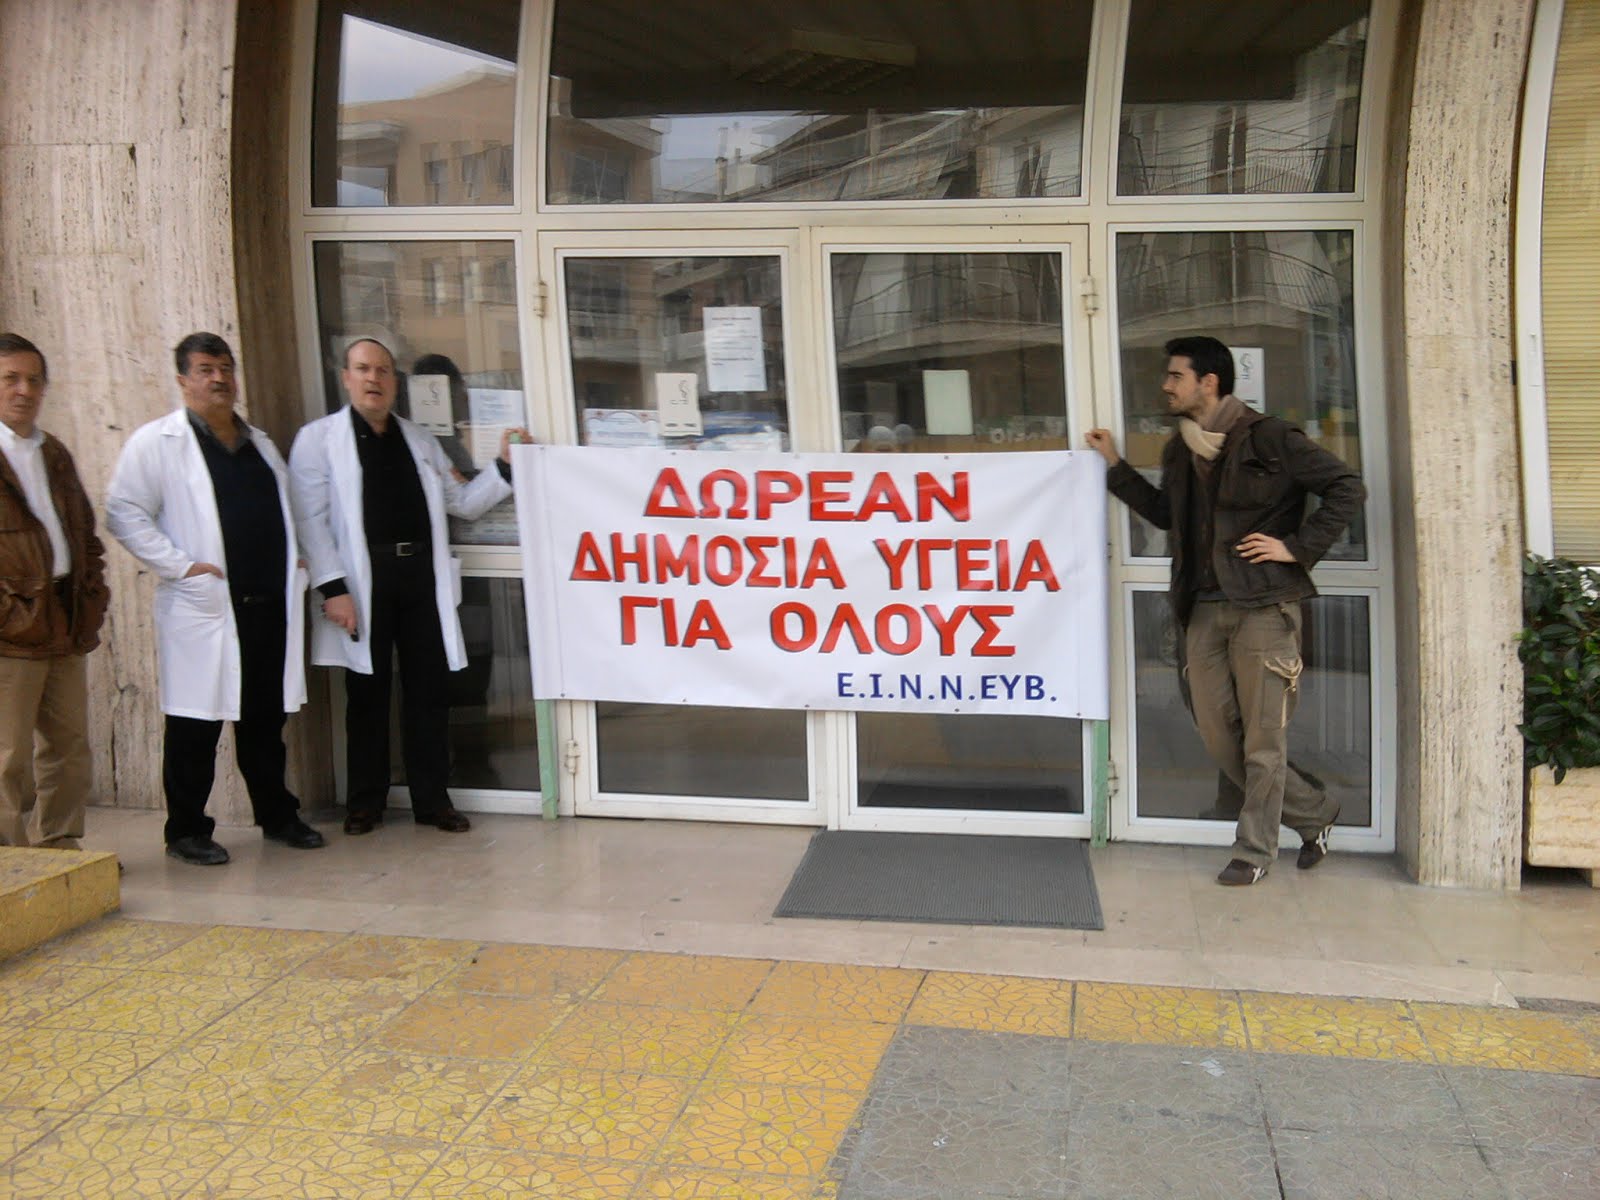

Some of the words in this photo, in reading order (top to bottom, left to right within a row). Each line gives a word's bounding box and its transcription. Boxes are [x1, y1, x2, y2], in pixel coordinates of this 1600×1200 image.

[643, 467, 972, 522] ΔΩΡΕΑΝ
[570, 532, 847, 589] ΔΗΜΟΣΙΑ
[875, 538, 1062, 592] ΥΓΕΙΑ
[620, 596, 733, 650] ΓΙΑ
[770, 602, 1017, 657] ΟΛΟΥΣ
